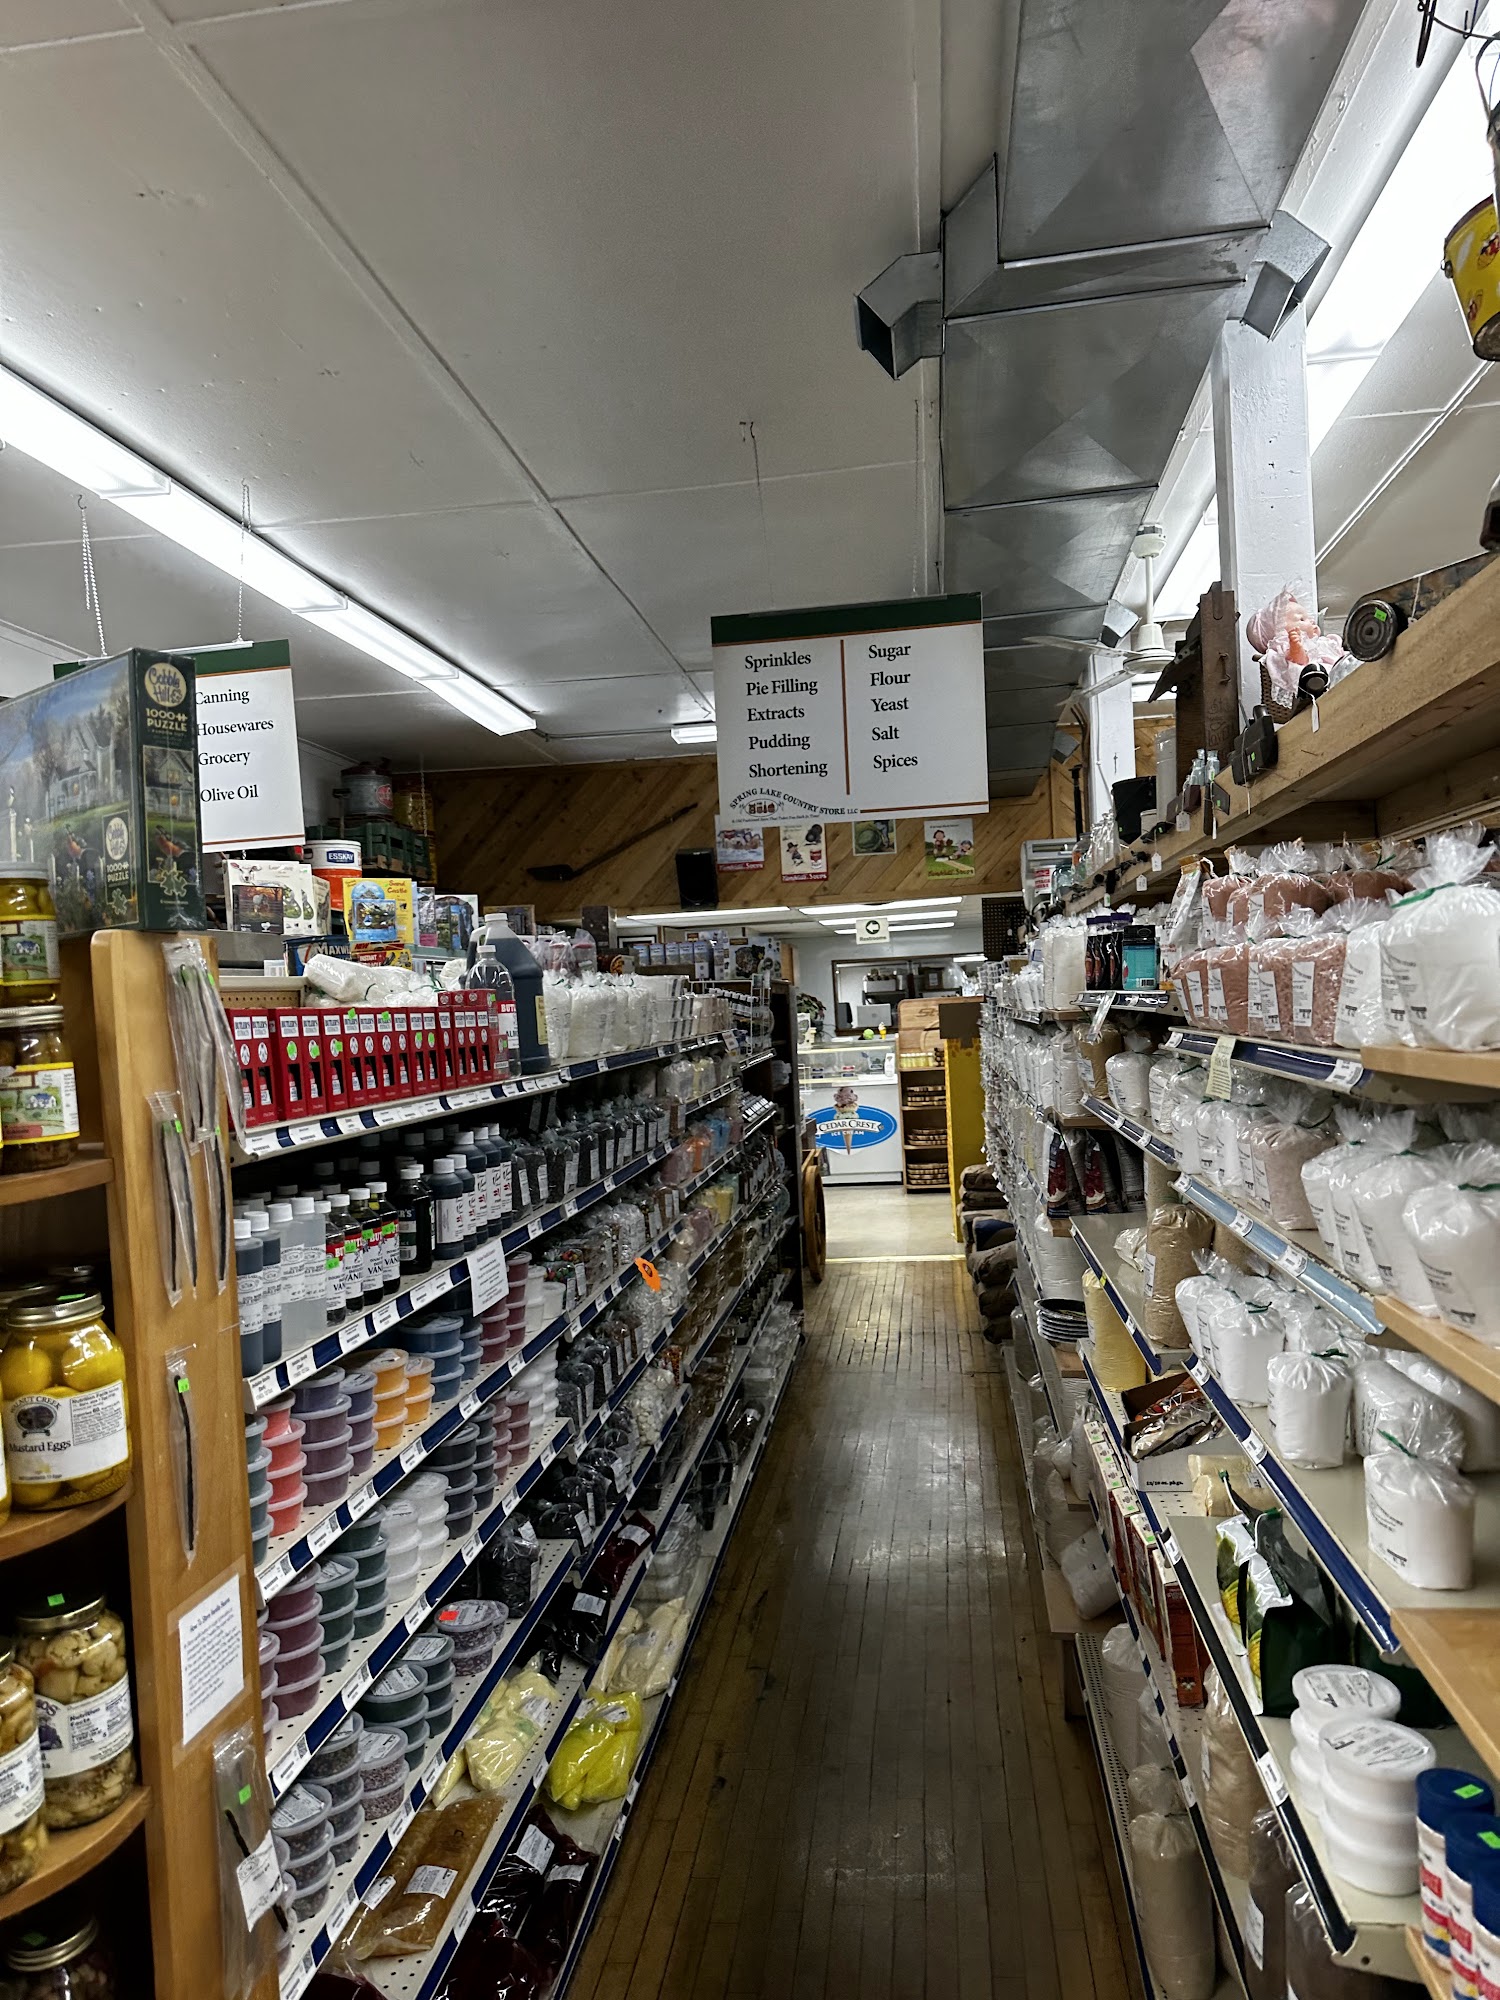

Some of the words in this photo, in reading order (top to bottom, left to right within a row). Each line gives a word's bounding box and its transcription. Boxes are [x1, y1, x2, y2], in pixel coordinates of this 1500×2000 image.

[868, 643, 911, 661] Sugar
[744, 652, 811, 672] Sprinkles
[149, 668, 180, 687] Cobble
[870, 671, 911, 687] Flour
[153, 685, 170, 703] Hill
[746, 681, 769, 696] Pie
[772, 679, 818, 695] Filling
[196, 689, 250, 705] Canning
[871, 697, 909, 712] Yeast
[747, 706, 805, 722] Extracts
[147, 718, 187, 732] PUZZLE
[197, 719, 274, 736] Housewares
[872, 726, 899, 741] Salt
[749, 734, 811, 751] Pudding
[199, 752, 250, 766] Grocery
[873, 755, 918, 773] Spices
[749, 761, 828, 779] Shortening
[200, 788, 235, 802] Olive
[237, 785, 258, 800] Oil
[729, 788, 758, 809] SPRING
[760, 787, 782, 798] LAKE
[783, 793, 819, 813] COUNTRY
[819, 807, 846, 815] STORE
[107, 871, 129, 883] PUZZLE
[819, 1120, 848, 1131] CEDAR
[36, 1396, 61, 1410] CREEK
[9, 1442, 45, 1453] Mustard
[47, 1440, 72, 1451] Eggs
